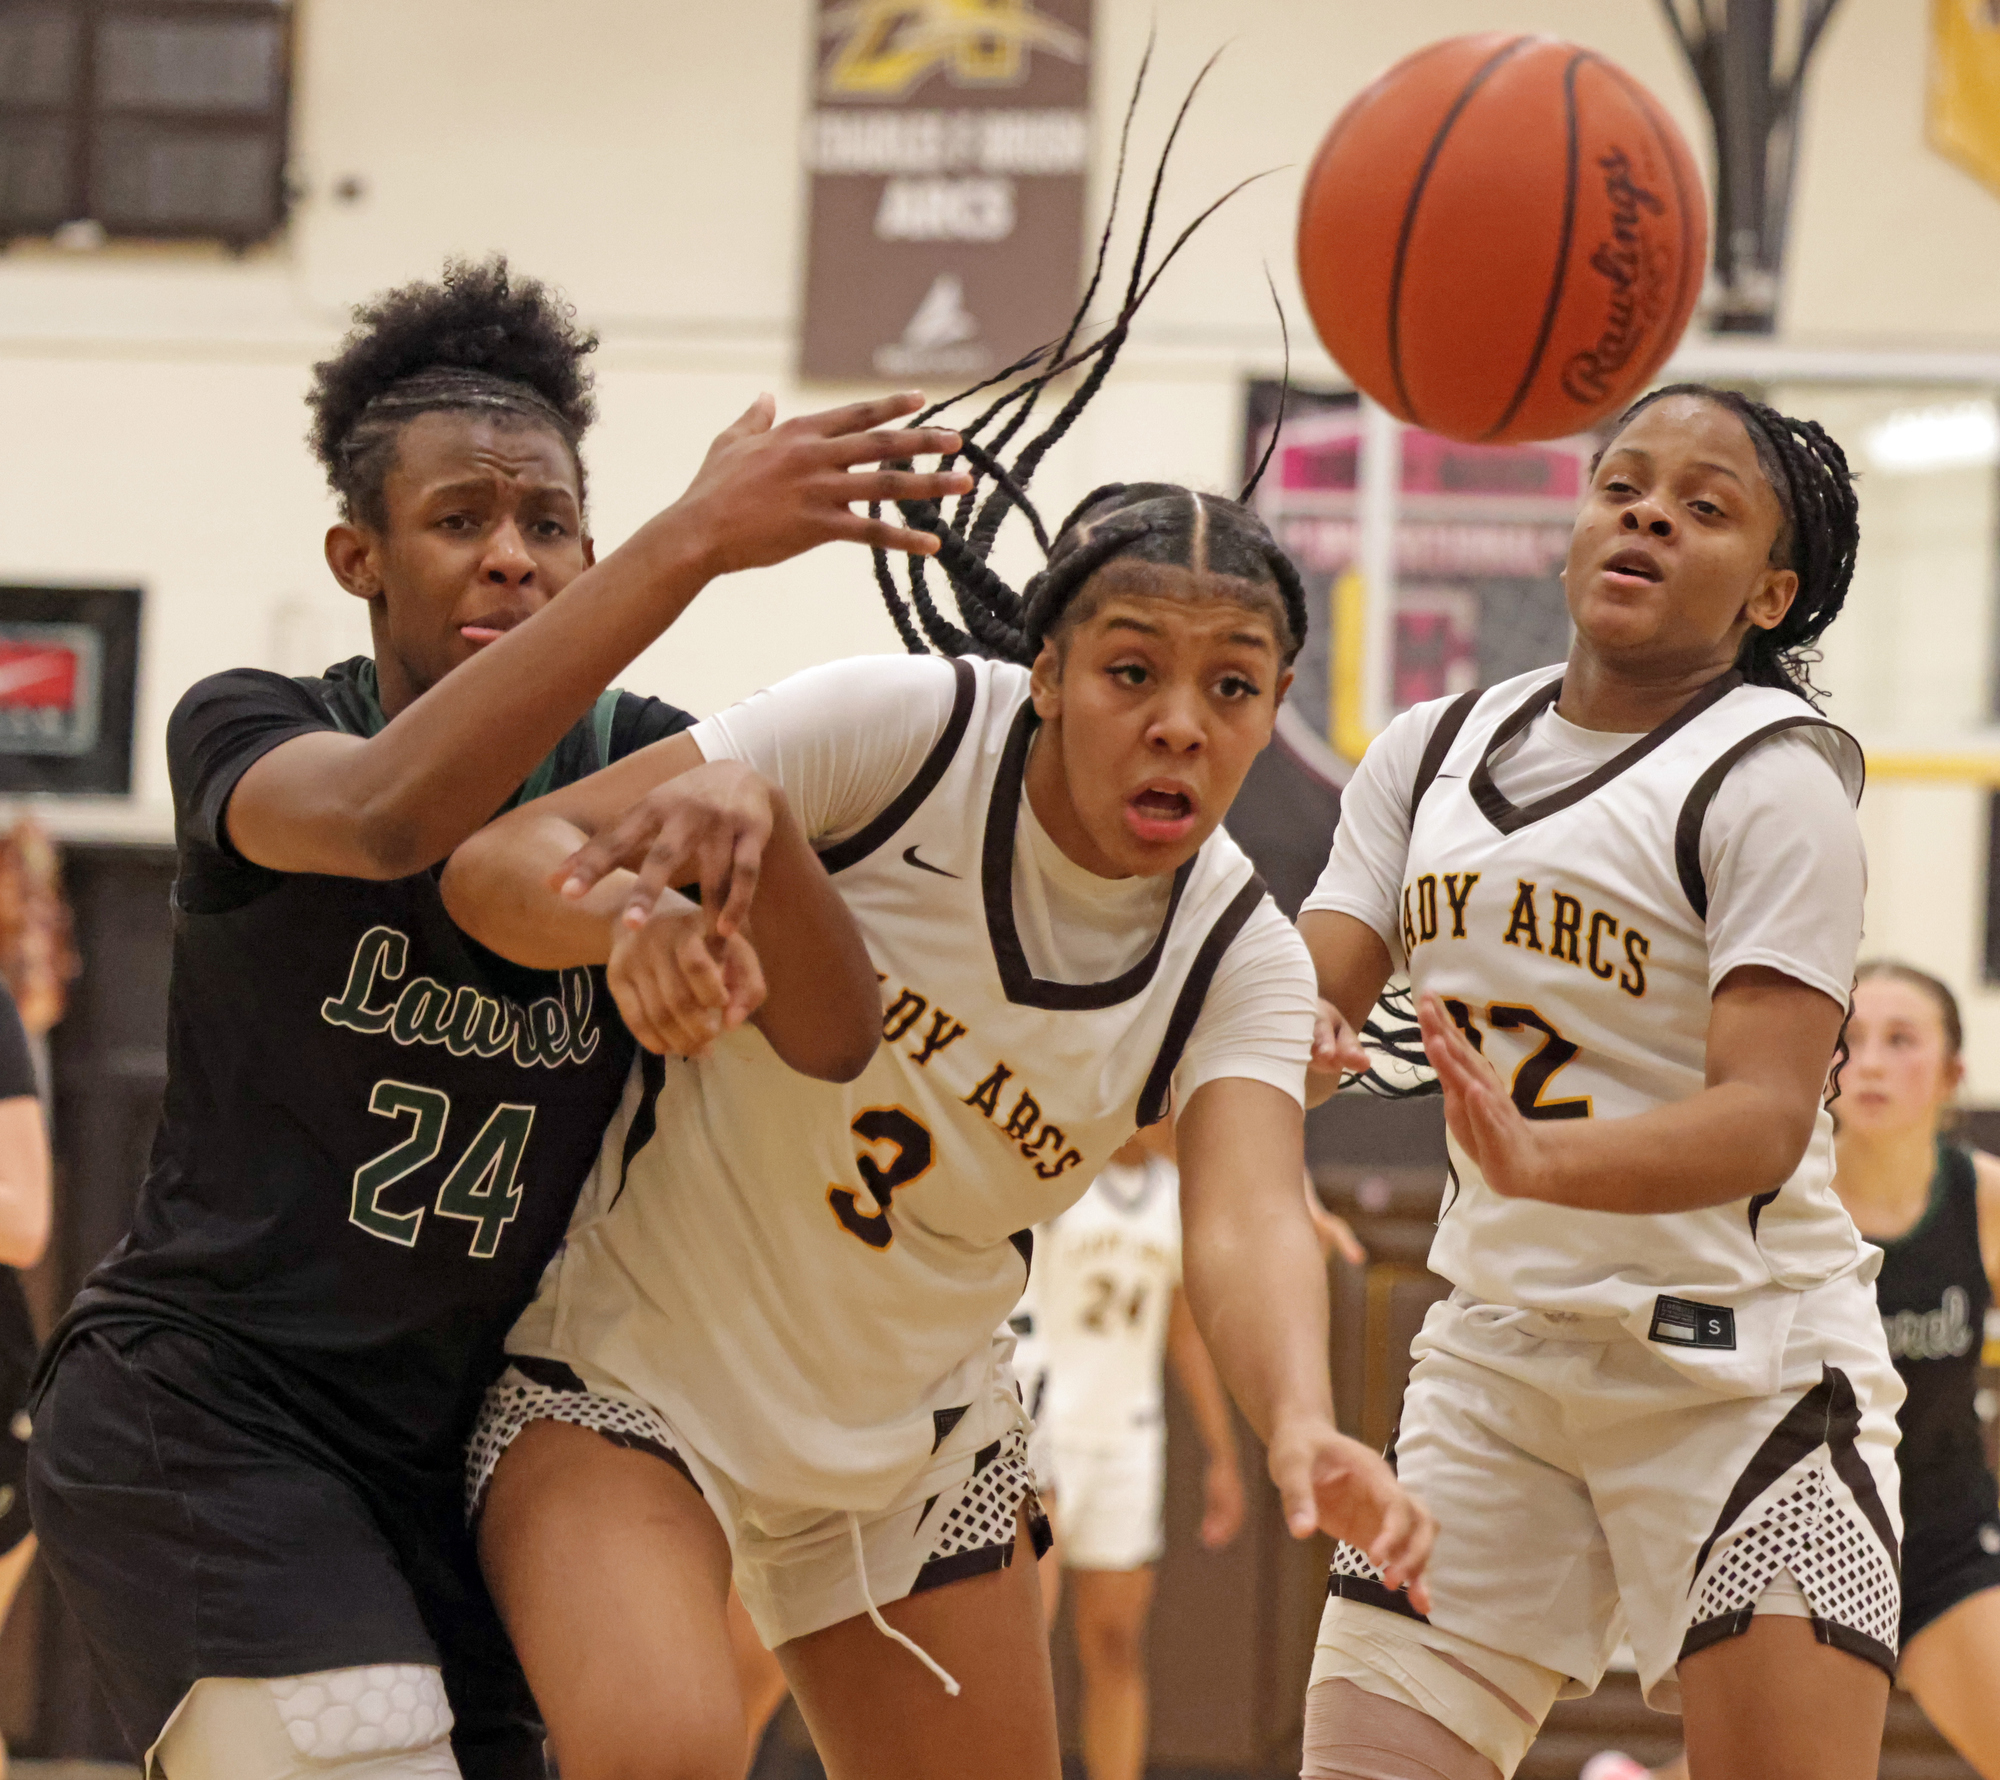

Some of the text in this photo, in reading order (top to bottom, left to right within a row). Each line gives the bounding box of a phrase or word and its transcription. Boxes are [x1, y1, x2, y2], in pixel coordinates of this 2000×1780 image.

[1560, 146, 1666, 404] Rawlings
[321, 925, 599, 1069] Laurel
[1402, 872, 1650, 998] ADY ARCS
[876, 972, 1084, 1181] DY ARCS
[348, 1079, 537, 1258] 24
[825, 1103, 937, 1252] 3
[1080, 1272, 1150, 1338] 24
[1707, 1318, 1722, 1336] S
